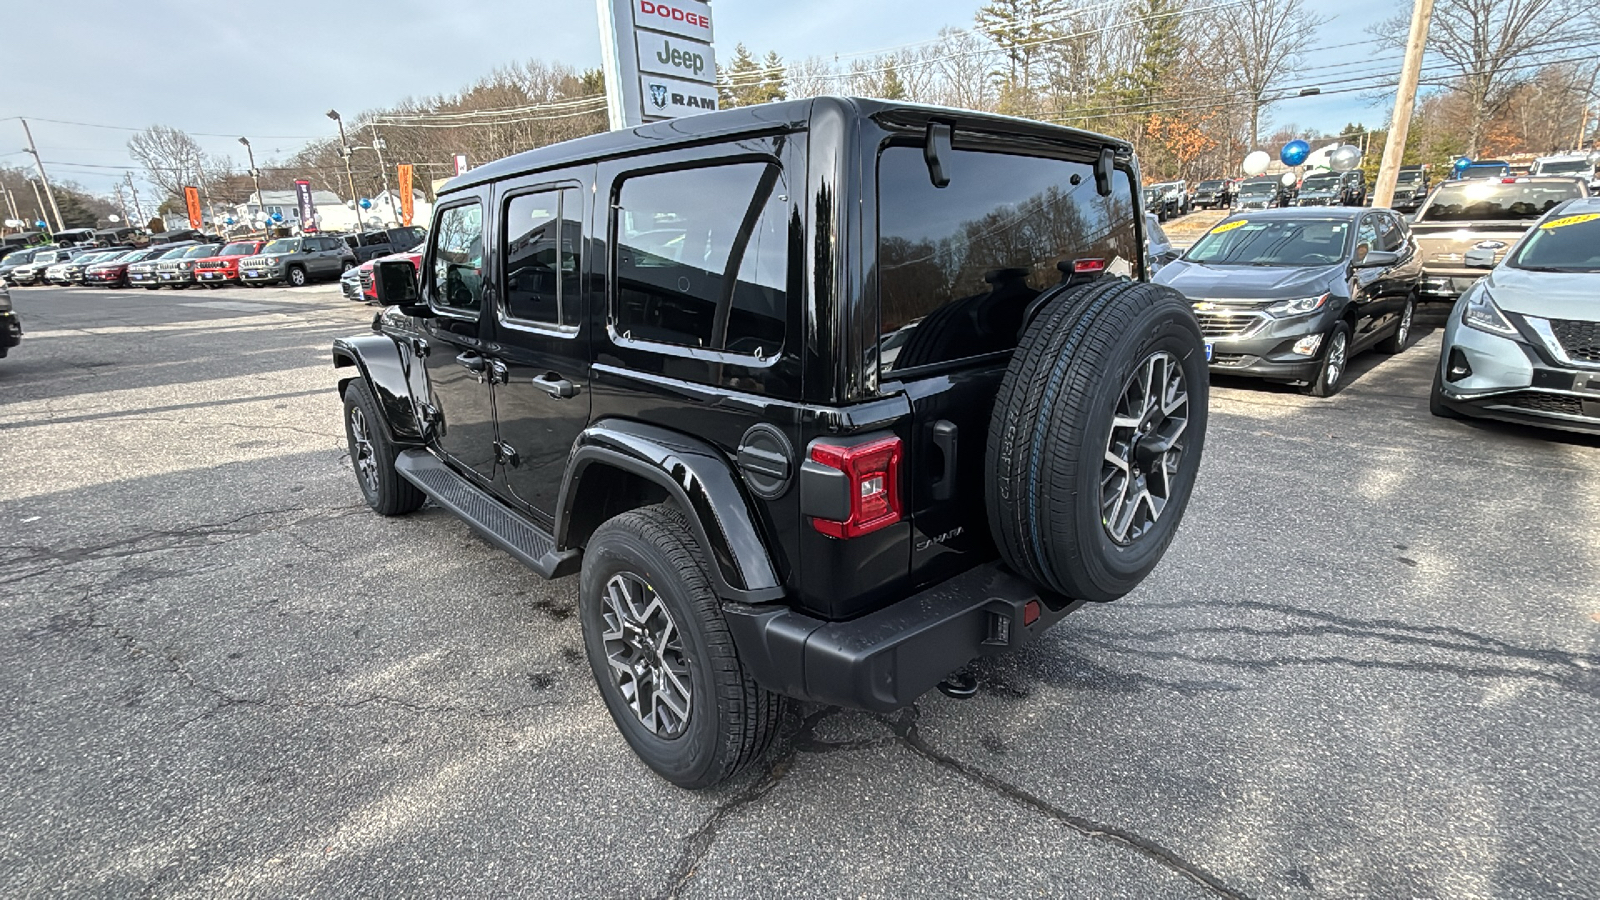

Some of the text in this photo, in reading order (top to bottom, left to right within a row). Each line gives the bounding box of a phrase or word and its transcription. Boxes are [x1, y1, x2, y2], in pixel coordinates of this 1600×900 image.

[640, 0, 710, 29] DODGE
[656, 39, 704, 75] Jeep
[671, 92, 716, 111] RAM
[915, 526, 965, 552] SAHARA
